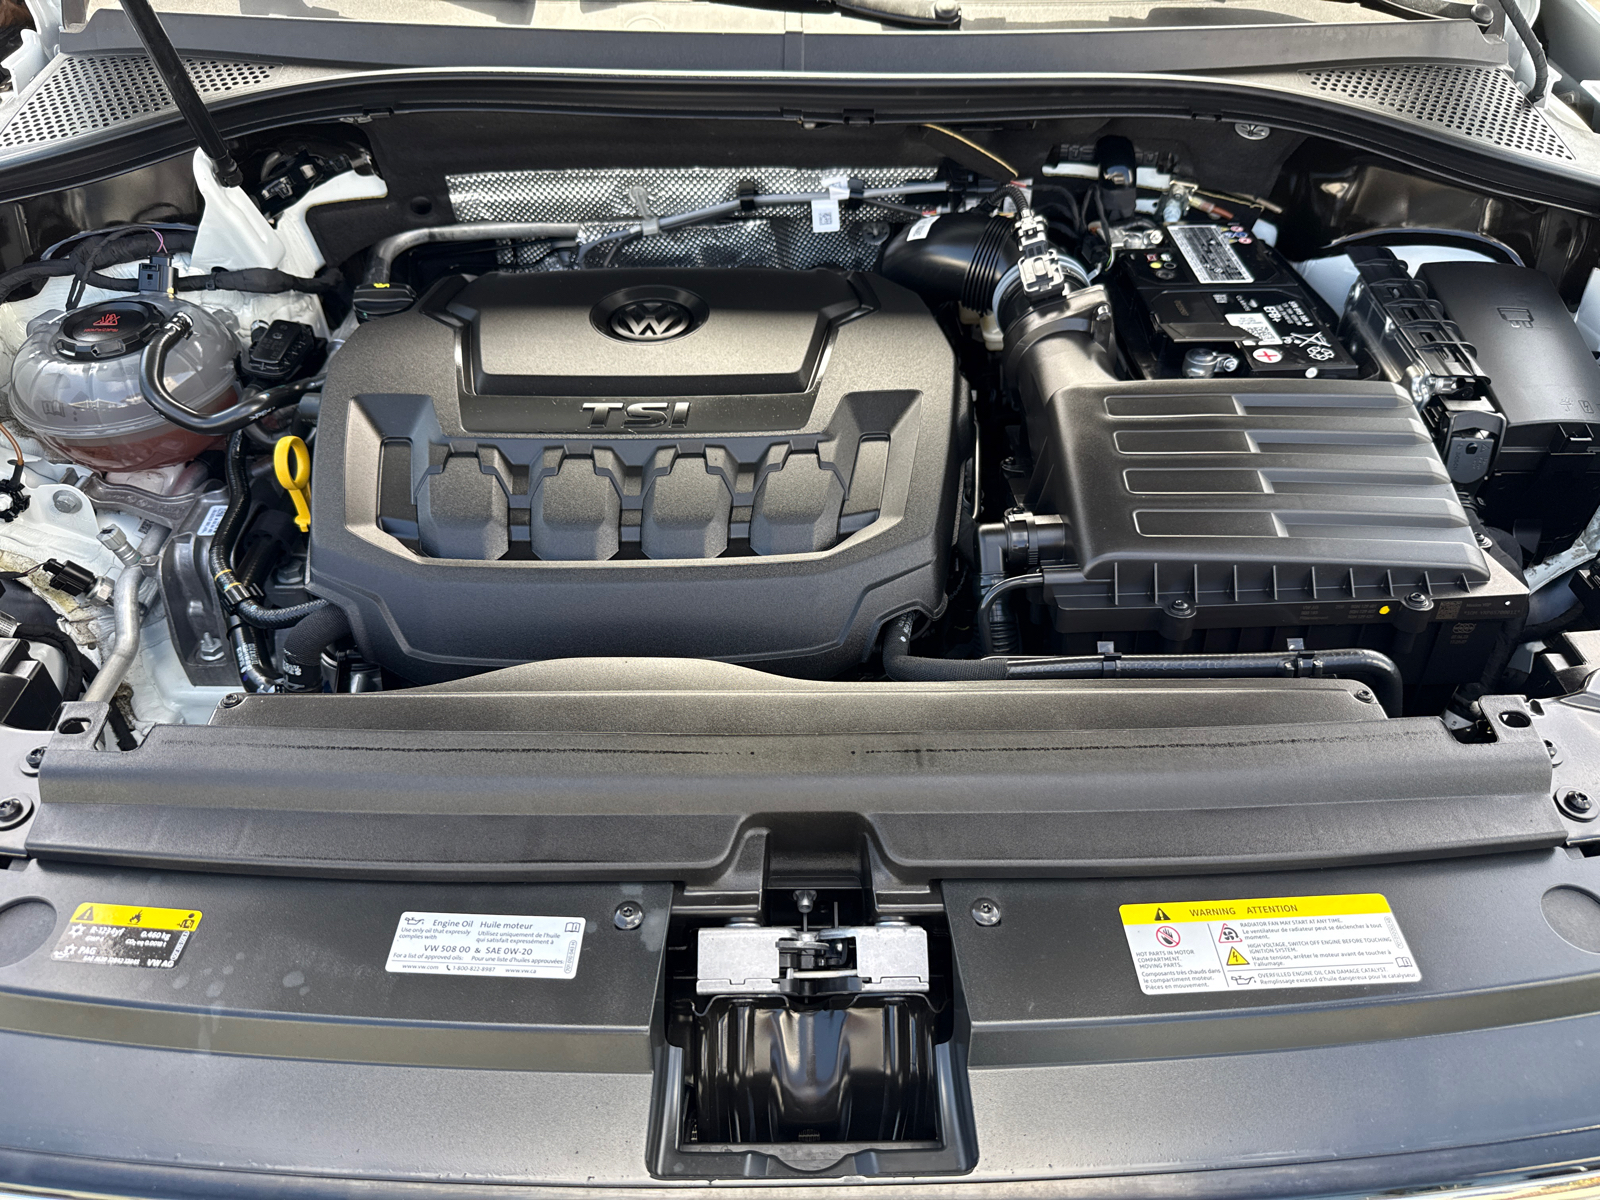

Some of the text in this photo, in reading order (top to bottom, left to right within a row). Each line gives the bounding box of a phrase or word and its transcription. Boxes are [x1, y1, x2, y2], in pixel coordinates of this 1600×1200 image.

[581, 402, 691, 428] TSI
[1189, 905, 1298, 916] WARNING ATTENTION
[433, 919, 460, 928] Engine
[78, 946, 97, 954] PAG
